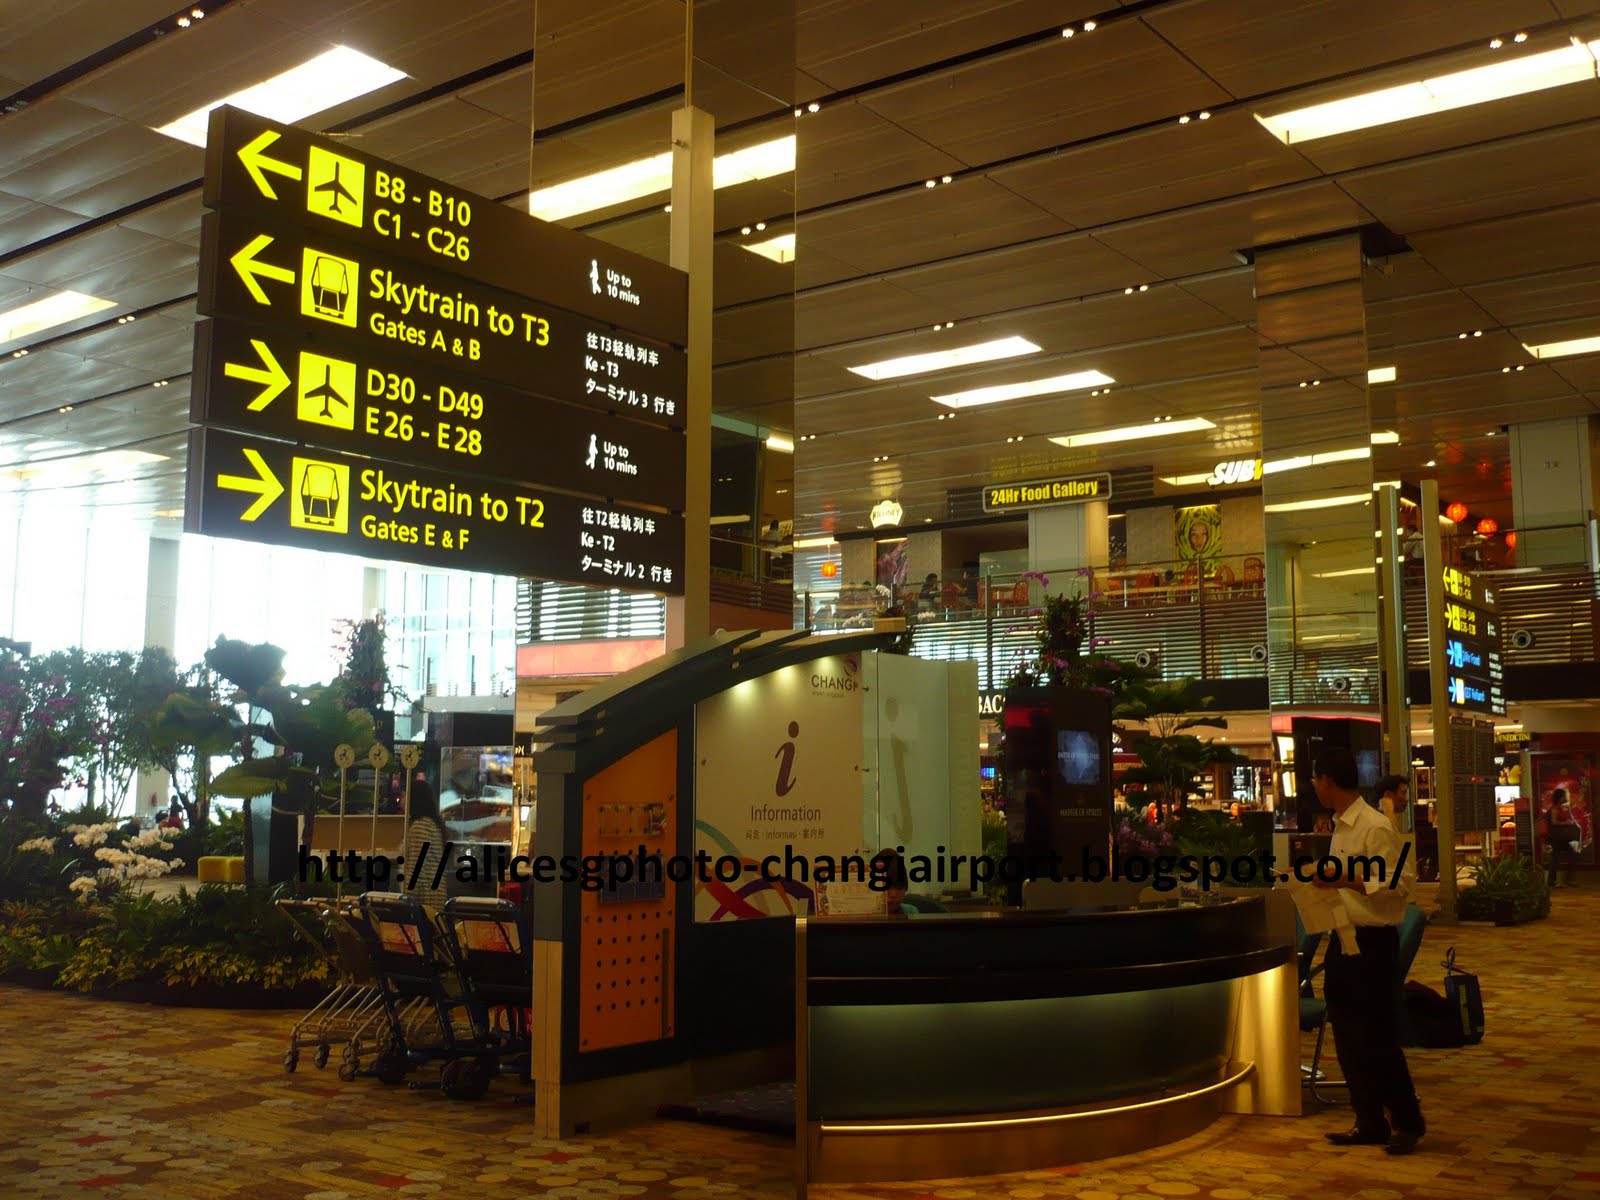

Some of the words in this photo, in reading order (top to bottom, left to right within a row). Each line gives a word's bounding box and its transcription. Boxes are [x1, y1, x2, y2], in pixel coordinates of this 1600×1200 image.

[375, 170, 406, 204] B8
[429, 190, 471, 227] B10
[373, 208, 401, 239] C1
[427, 227, 470, 261] C26
[607, 269, 620, 286] Up
[621, 275, 632, 288] to
[370, 268, 479, 327] Skytrain
[487, 305, 514, 336] to
[521, 313, 550, 346] T3
[607, 284, 618, 298] 10
[619, 290, 640, 306] mins
[370, 312, 426, 346] Gates
[431, 329, 447, 352] A
[452, 338, 464, 357] &
[469, 339, 481, 360] B
[585, 355, 598, 372] Ke
[607, 361, 619, 378] T3
[367, 368, 415, 404] D30
[439, 385, 484, 420] D49
[654, 396, 676, 416] 行き
[366, 407, 413, 442] E26
[438, 422, 482, 456] E28
[604, 441, 617, 457] Up
[618, 446, 629, 458] to
[604, 457, 615, 471] 10
[616, 461, 638, 475] mins
[360, 469, 473, 517] Skytrain
[480, 492, 508, 522] to
[515, 496, 545, 528] T2
[991, 488, 1019, 506] 24Hr
[1021, 484, 1050, 502] Food
[1052, 480, 1098, 498] Gallery
[361, 515, 418, 544] Gates
[425, 524, 436, 546] E
[442, 530, 453, 548] &
[459, 529, 469, 550] F
[581, 531, 594, 549] Ke
[602, 535, 615, 551] T2
[651, 566, 673, 584] 行き
[750, 804, 821, 821] Information
